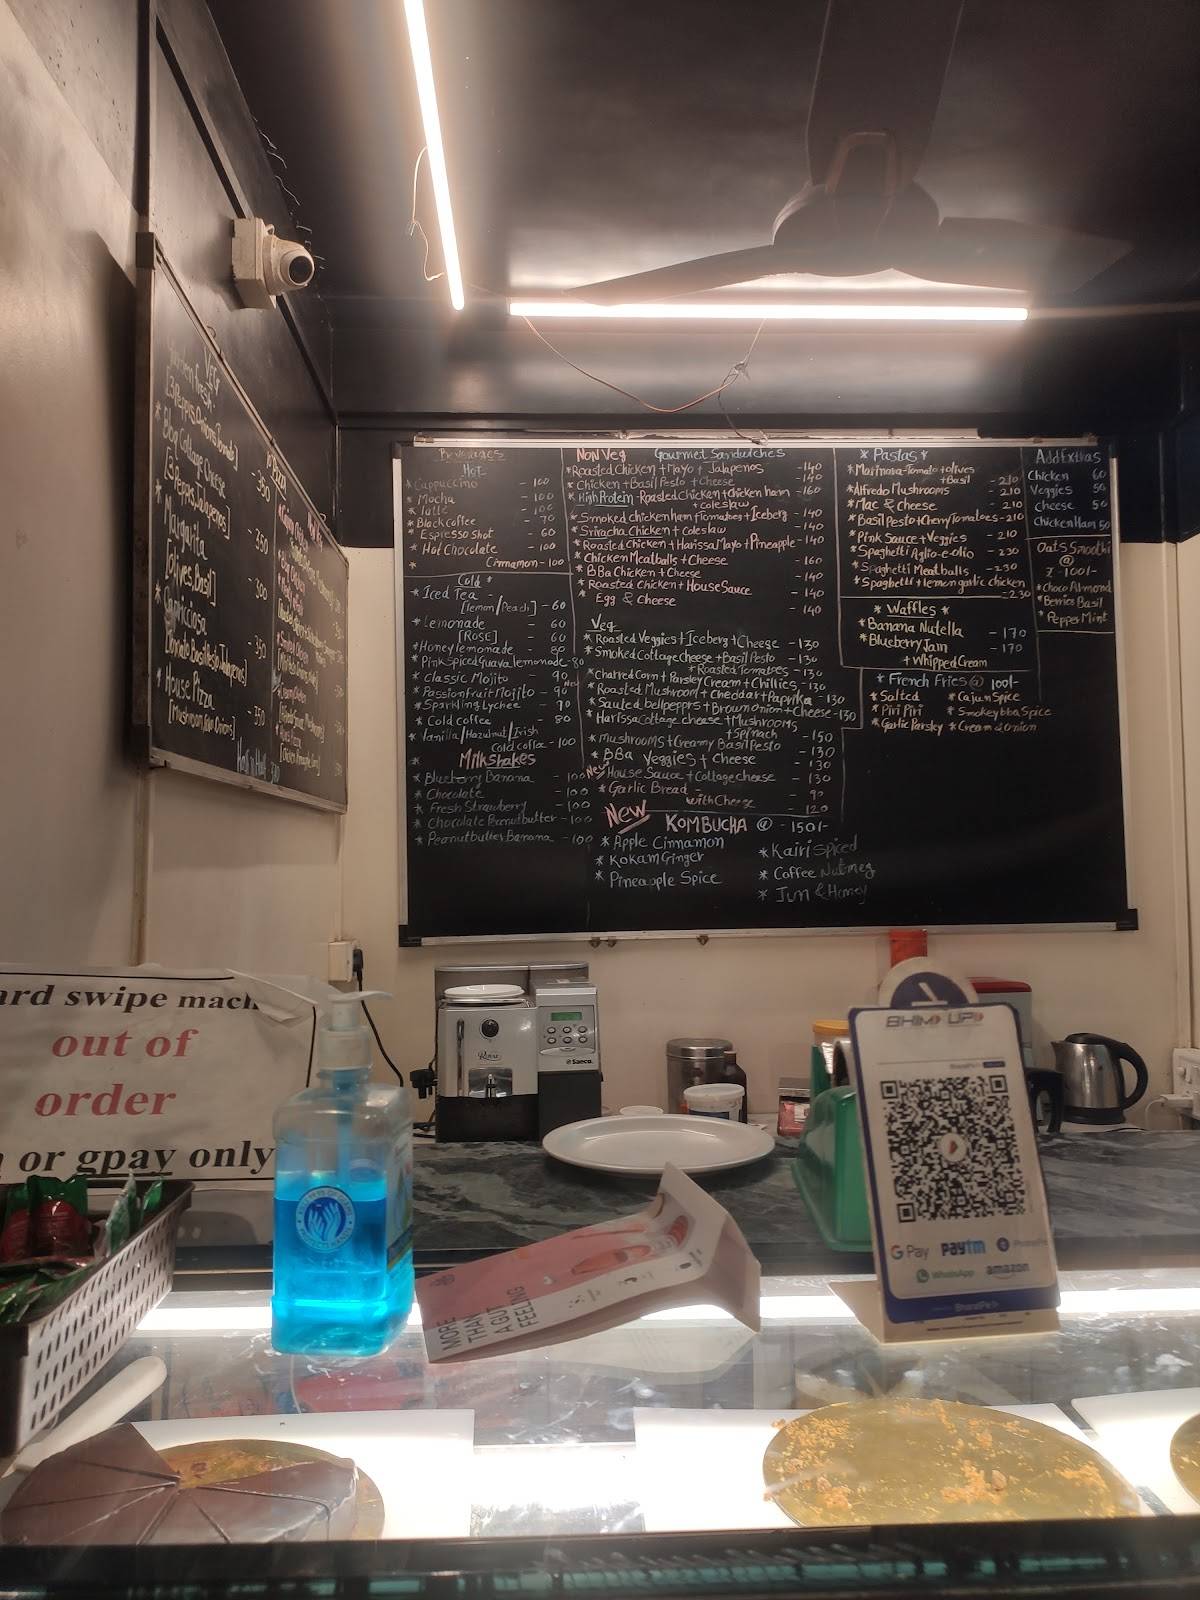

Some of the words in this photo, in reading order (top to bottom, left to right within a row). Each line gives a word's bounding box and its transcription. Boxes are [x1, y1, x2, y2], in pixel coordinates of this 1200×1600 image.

[614, 463, 656, 476] Chicken
[1027, 469, 1070, 482] Chicken
[857, 530, 882, 544] Pink
[595, 593, 616, 607] Egg
[636, 593, 677, 607] Cheese
[886, 600, 937, 617] Waffles
[590, 613, 616, 633] Veg
[867, 617, 916, 634] Banana
[919, 620, 965, 638] Nutella
[424, 671, 467, 684] Classic
[471, 673, 509, 688] Mojito
[613, 832, 648, 852] Apple
[652, 836, 725, 849] Cinnamon
[680, 870, 722, 886] Spice
[64, 986, 168, 1013] swipe
[52, 1030, 132, 1058] out
[145, 1029, 199, 1058] of
[34, 1083, 176, 1117] order
[19, 1151, 66, 1172] or
[76, 1149, 177, 1176] gpay
[189, 1140, 276, 1175] only
[906, 1244, 930, 1261] Pay
[436, 1316, 462, 1351] MORE
[459, 1312, 488, 1343] THAN
